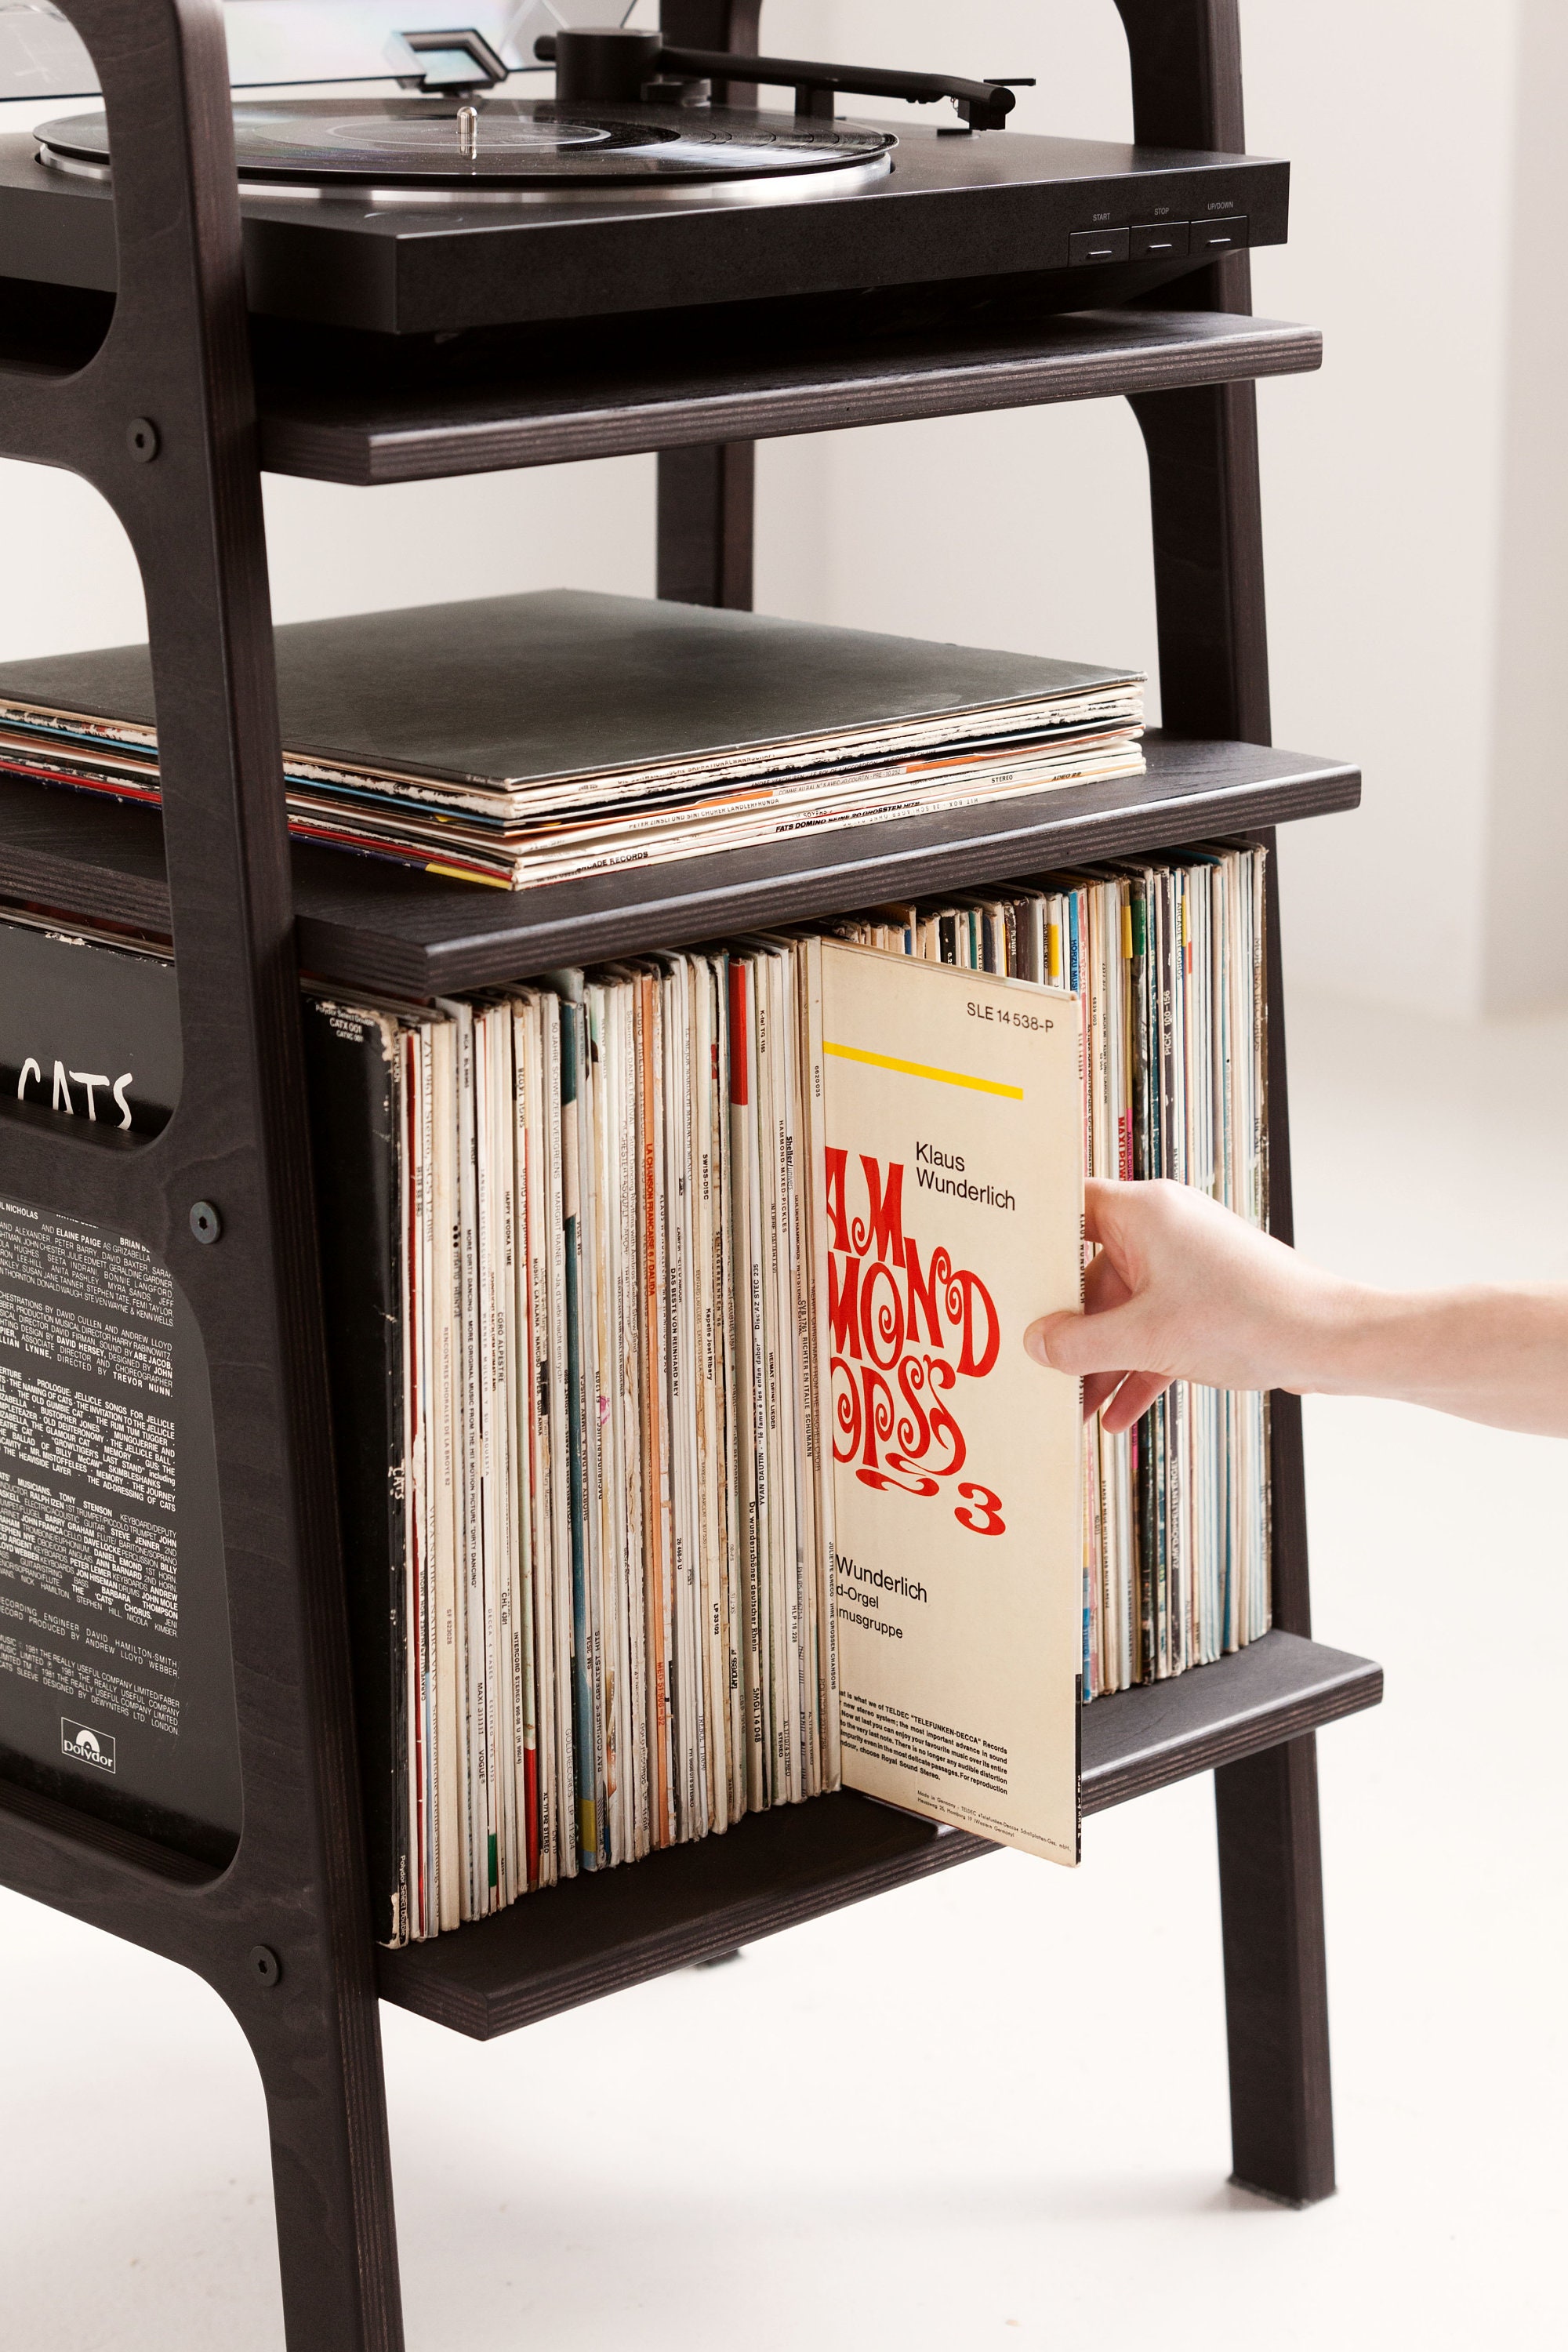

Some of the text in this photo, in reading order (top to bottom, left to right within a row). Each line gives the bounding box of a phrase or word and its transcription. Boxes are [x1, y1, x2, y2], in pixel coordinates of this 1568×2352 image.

[1207, 201, 1233, 210] UP/DOWN
[992, 775, 1013, 783] STEREO
[775, 819, 826, 833] FATS DOMINO
[610, 851, 648, 864] RECORDS
[551, 1022, 559, 1033] 50
[967, 1003, 1054, 1033] SLE 14 538-P
[18, 1058, 133, 1133] CATS
[646, 1143, 652, 1154] LA
[916, 1142, 965, 1171] Klaus
[916, 1167, 1015, 1210] Wunderlich
[5, 1203, 38, 1220] NICHOLAS
[826, 1146, 906, 1267] AM
[42, 1223, 151, 1262] AND ELAINE PAIGE AS GRIZABELLA
[120, 1237, 140, 1250] BRIAN
[45, 1305, 172, 1352] BY DAVID CULLEN AND ANDREW LLOYD
[57, 1353, 91, 1371] DIRECTED
[98, 1367, 107, 1377] BY
[113, 1371, 142, 1388] TREVOR
[148, 1382, 172, 1397] NUNN.
[804, 1373, 810, 1383] EN
[17, 1390, 167, 1446] THE OLD GUMBIE CAT THE RUM TUM TUGGER
[74, 1391, 101, 1407] JELLICLE
[104, 1400, 126, 1415] SONGS
[130, 1409, 143, 1421] FOR
[146, 1414, 175, 1431] JELLICLE
[444, 1426, 449, 1436] DE
[831, 1355, 966, 1497] OPS
[445, 1438, 449, 1448] LA
[445, 1478, 450, 1486] 82
[749, 1501, 756, 1515] Du
[955, 1483, 1006, 1536] 3
[750, 1516, 758, 1582] wunderschöner
[836, 1554, 927, 1602] Wunderlich
[837, 1584, 878, 1609] d-Orgel
[838, 1608, 903, 1639] musgruppe
[28, 1615, 65, 1636] PRODUCED
[71, 1631, 79, 1642] BY
[85, 1636, 114, 1655] ANDREW
[120, 1650, 143, 1665] LLOYD
[753, 1714, 760, 1724] 14
[854, 1695, 867, 1704] what
[886, 1706, 909, 1719] TELDEC
[983, 1740, 1007, 1754] Records
[64, 1740, 113, 1766] polydor
[859, 1747, 880, 1759] choose
[881, 1754, 898, 1765] Royal
[899, 1760, 918, 1772] Sound
